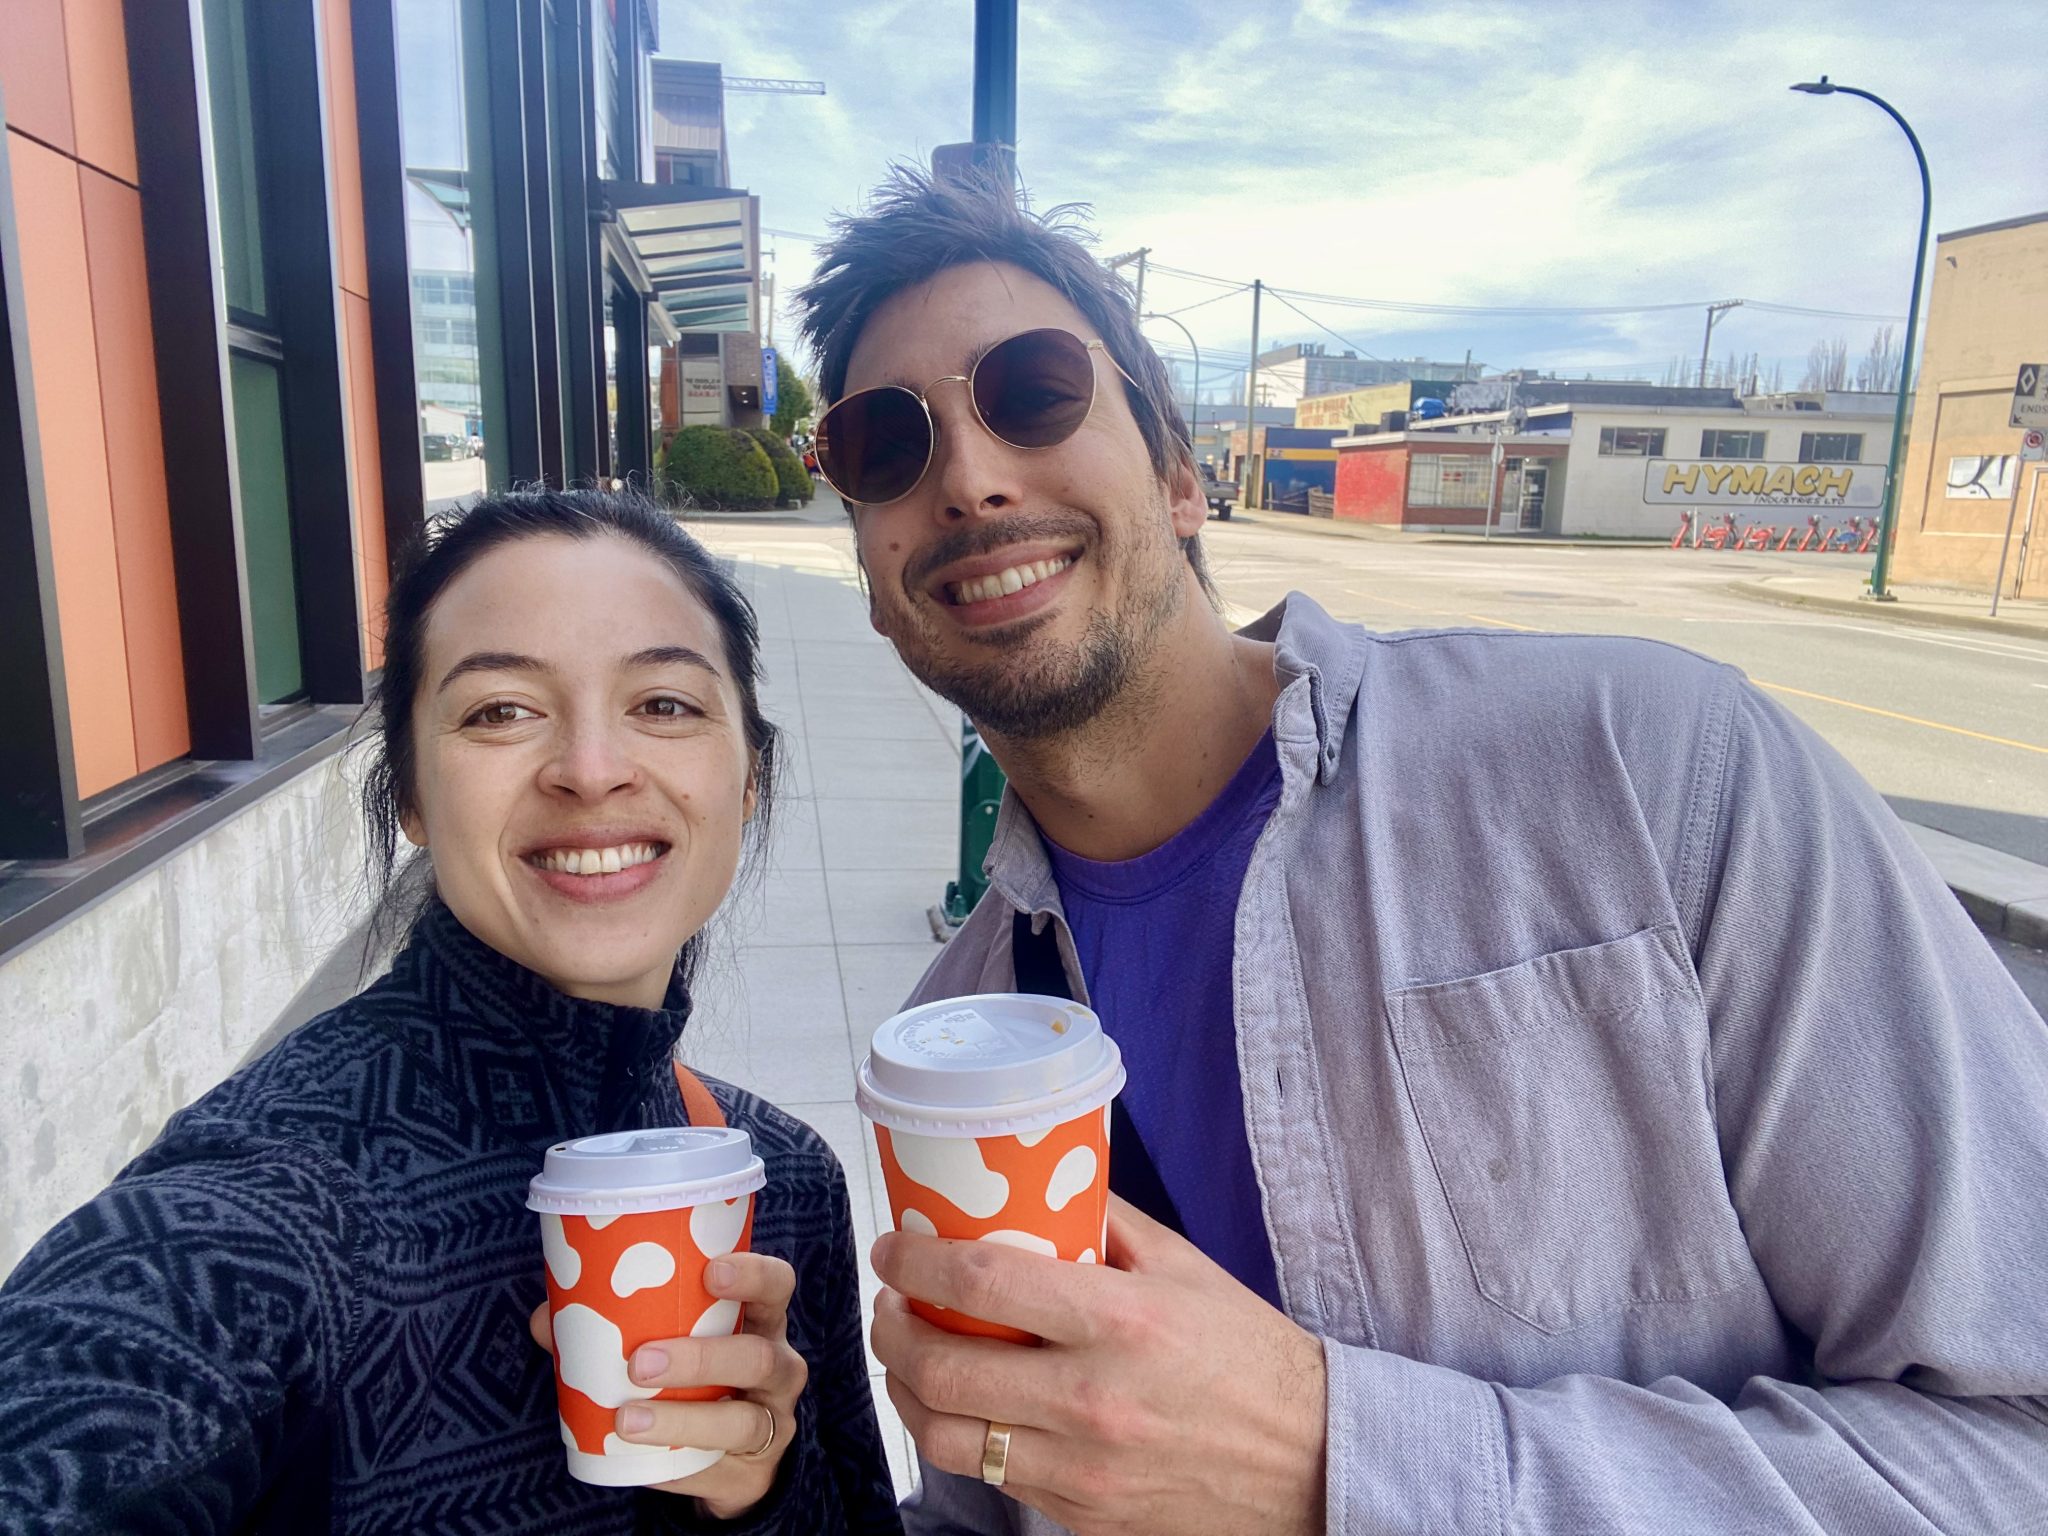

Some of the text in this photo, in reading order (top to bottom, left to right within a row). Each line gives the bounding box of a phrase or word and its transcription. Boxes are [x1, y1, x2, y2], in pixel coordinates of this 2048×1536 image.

[1662, 464, 1854, 497] HYMACH
[1753, 495, 1845, 505] INDUSTRIES LTD
